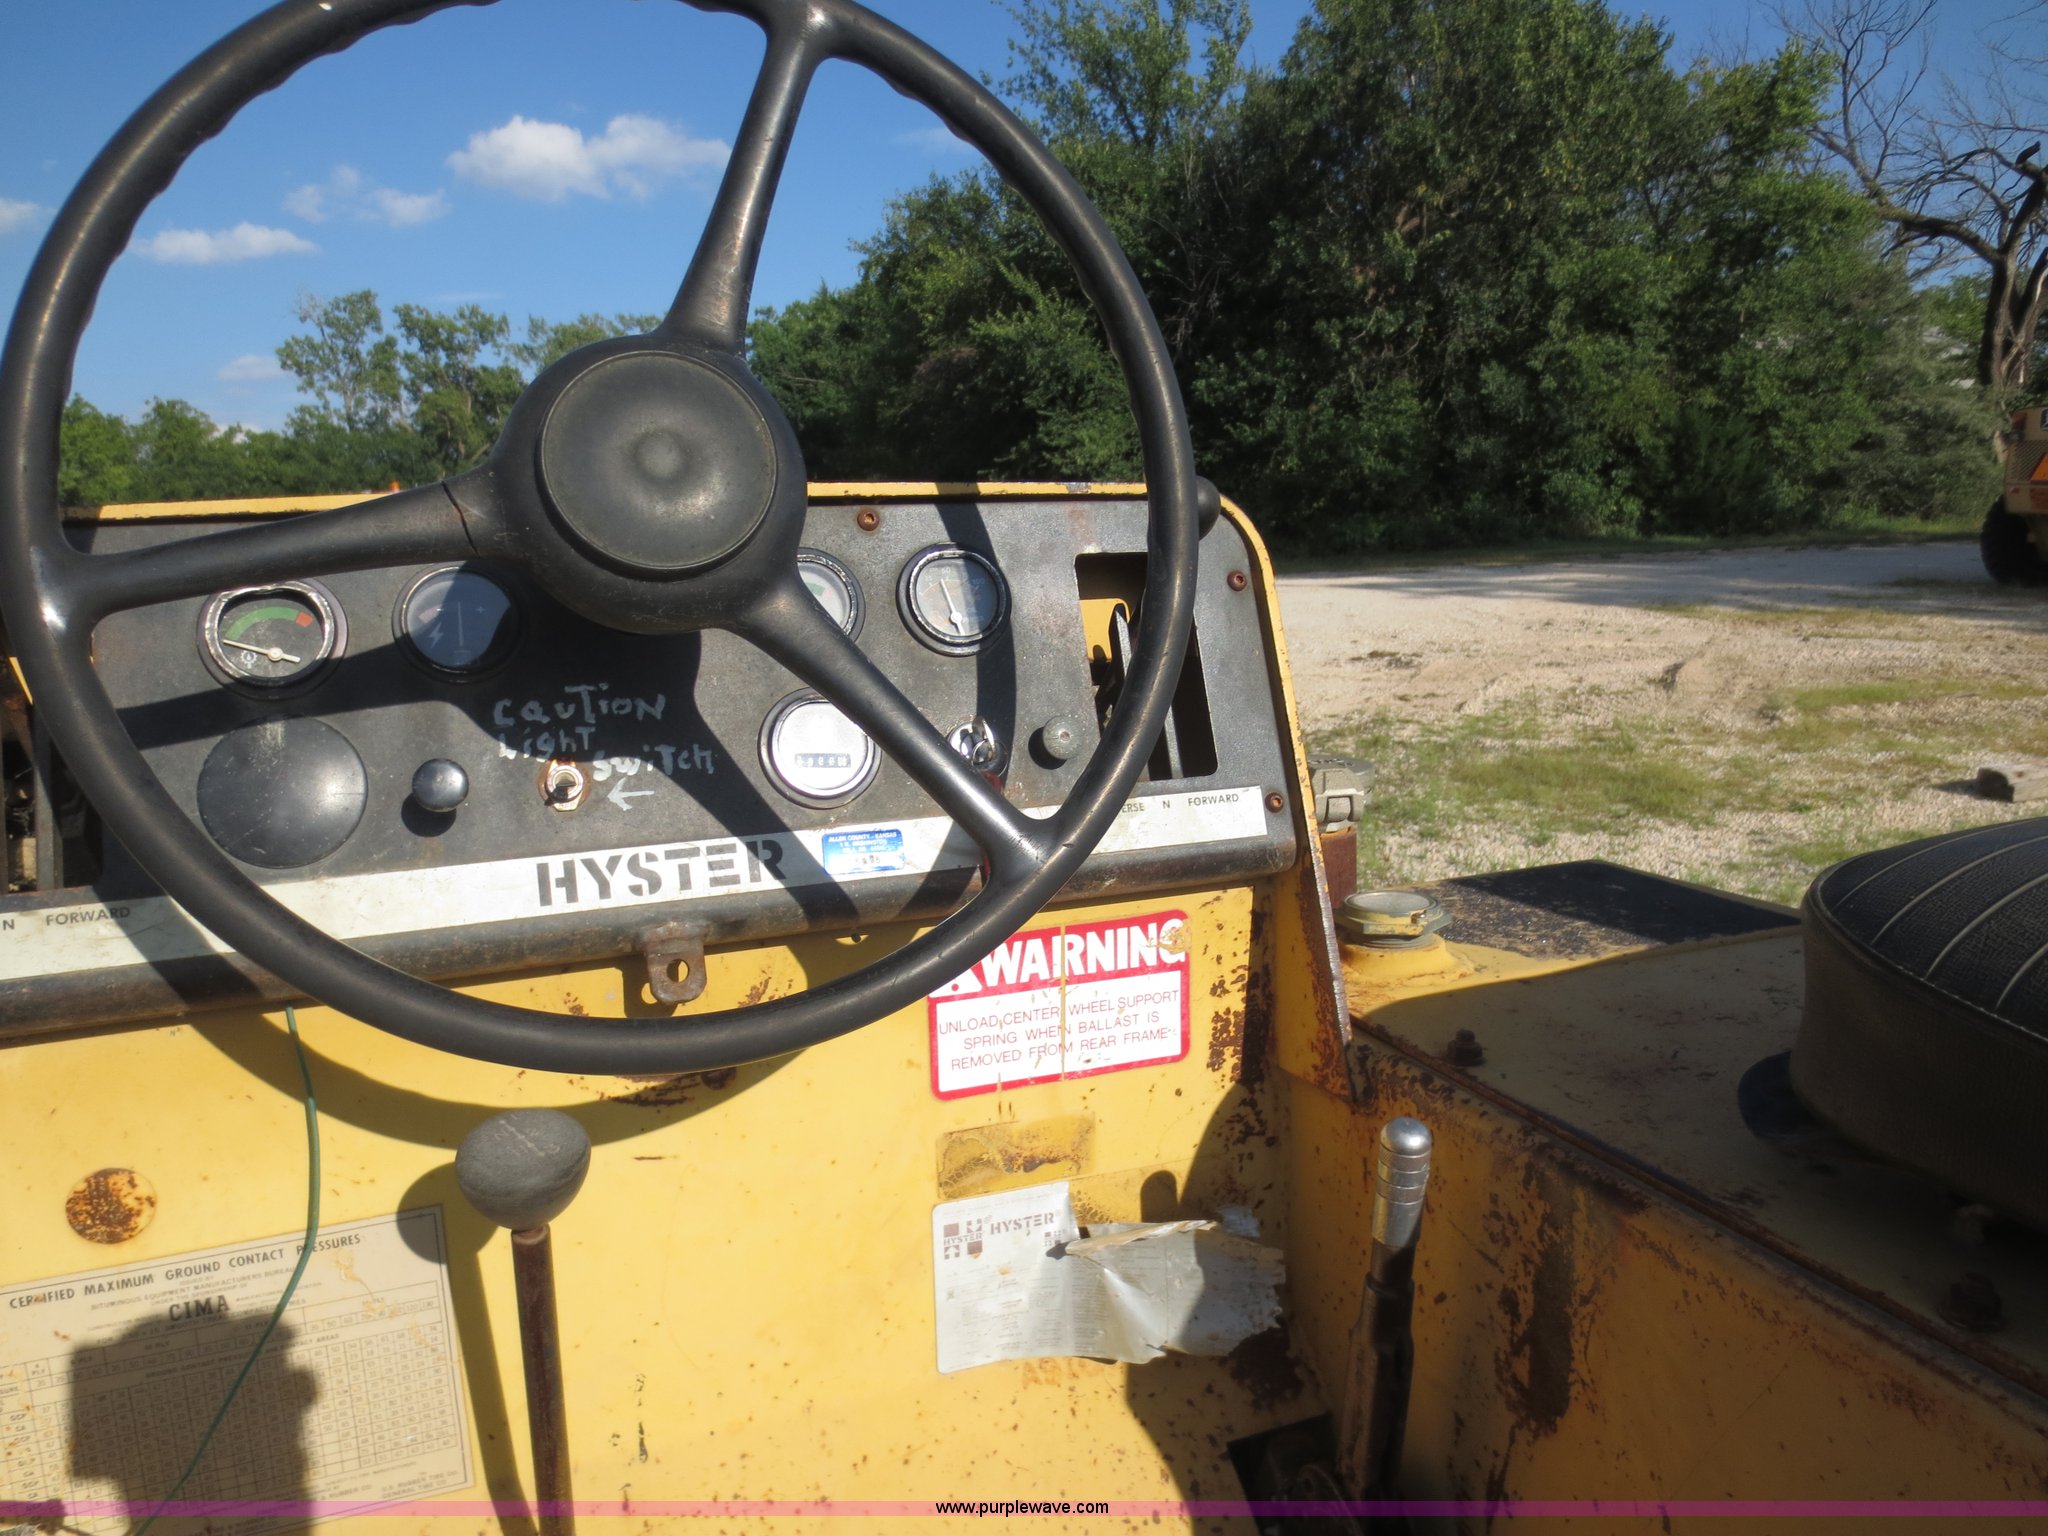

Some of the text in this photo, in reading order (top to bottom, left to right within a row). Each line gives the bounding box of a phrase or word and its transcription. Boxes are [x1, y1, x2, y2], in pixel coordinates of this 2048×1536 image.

[1162, 800, 1170, 809] N
[1188, 793, 1239, 807] FORWARD
[536, 839, 787, 907] HYSTER
[2, 906, 131, 931] N FORWARD
[981, 918, 1187, 988] WARNING
[939, 990, 1180, 1035] UNLOAD CENTER WHEEL SUPPORT
[964, 1011, 1160, 1050] SPRING WHEN BALLAST IS
[951, 1027, 1169, 1071] REMOVED FROM REAR FRAME
[943, 1212, 1055, 1246] HYSTER HYSTER
[9, 1233, 361, 1309] CERIFIED MAXIMUM GROUND CONTACT PESSURES
[168, 1295, 230, 1322] CIMA
